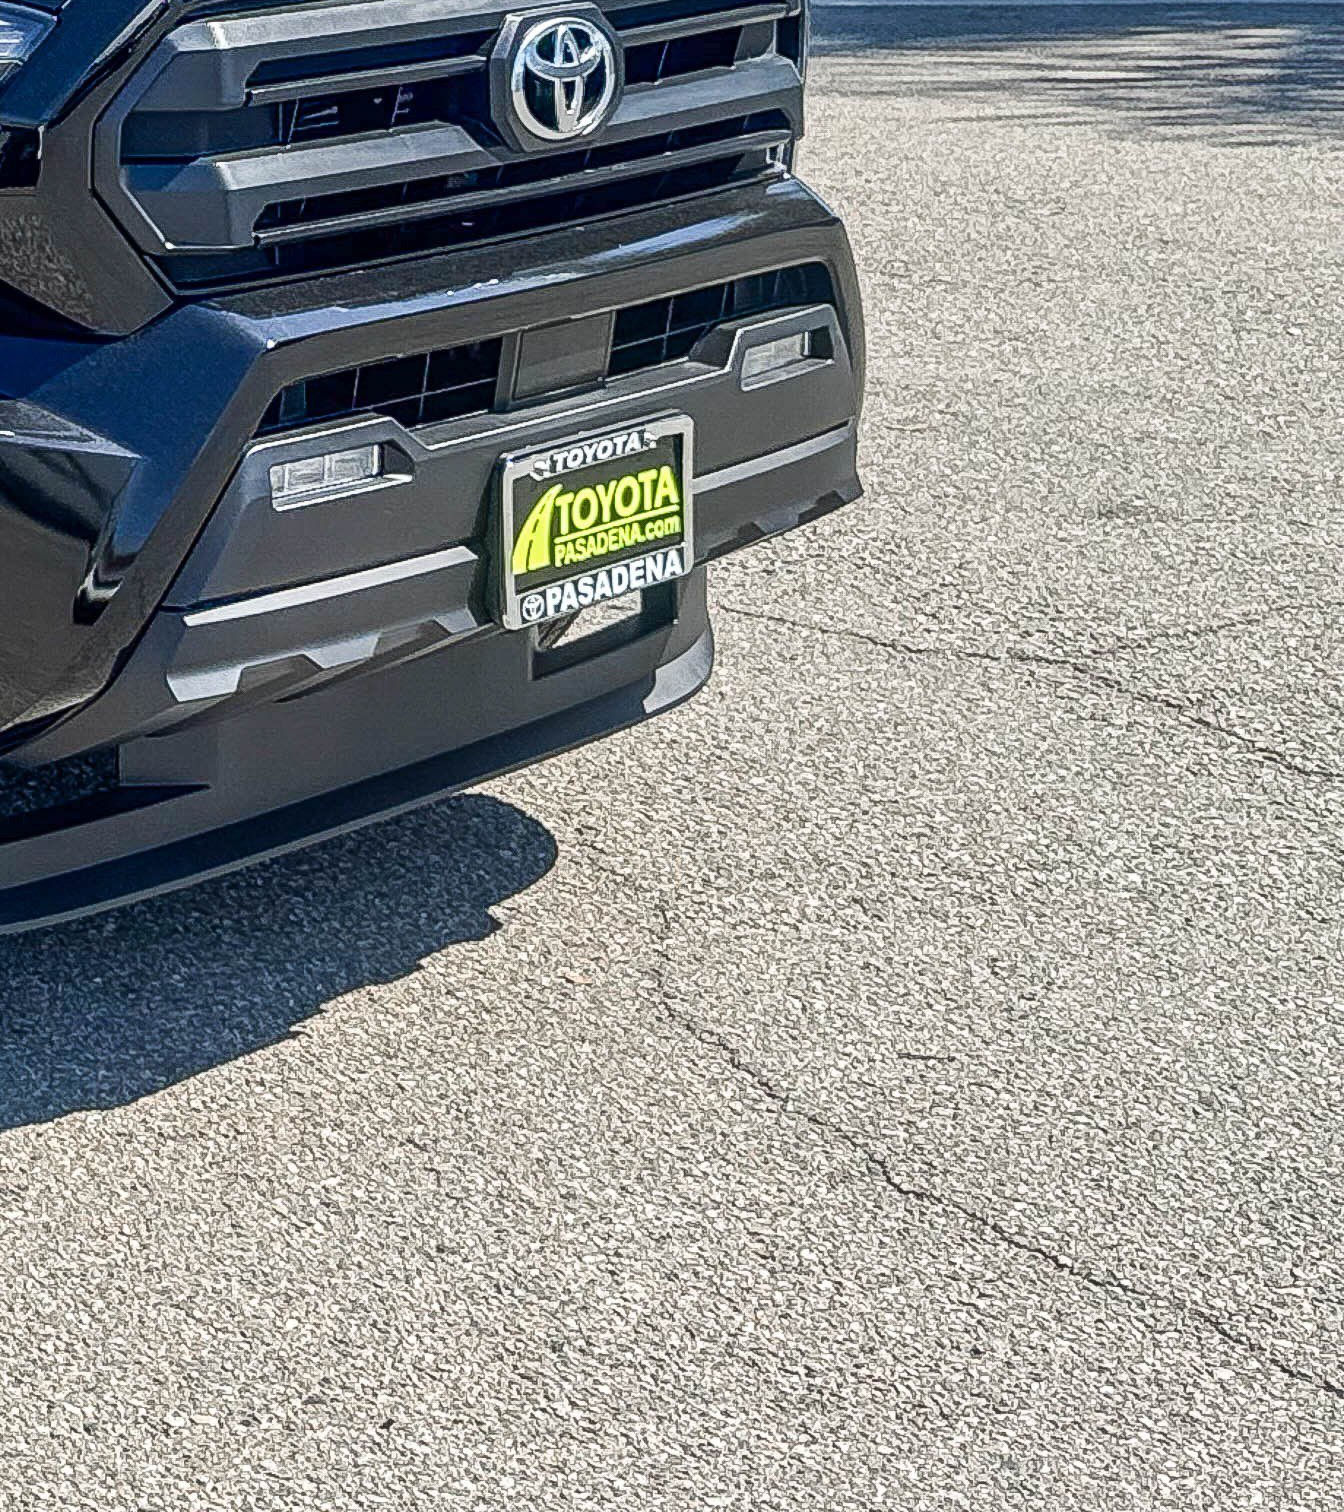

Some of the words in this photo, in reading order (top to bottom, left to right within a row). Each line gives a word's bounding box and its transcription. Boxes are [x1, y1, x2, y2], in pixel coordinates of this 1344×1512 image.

[553, 431, 642, 473] TOYOTA
[554, 465, 680, 535] TOYOTA
[554, 514, 682, 568] PASADENA.com
[545, 549, 683, 616] PASADENA
